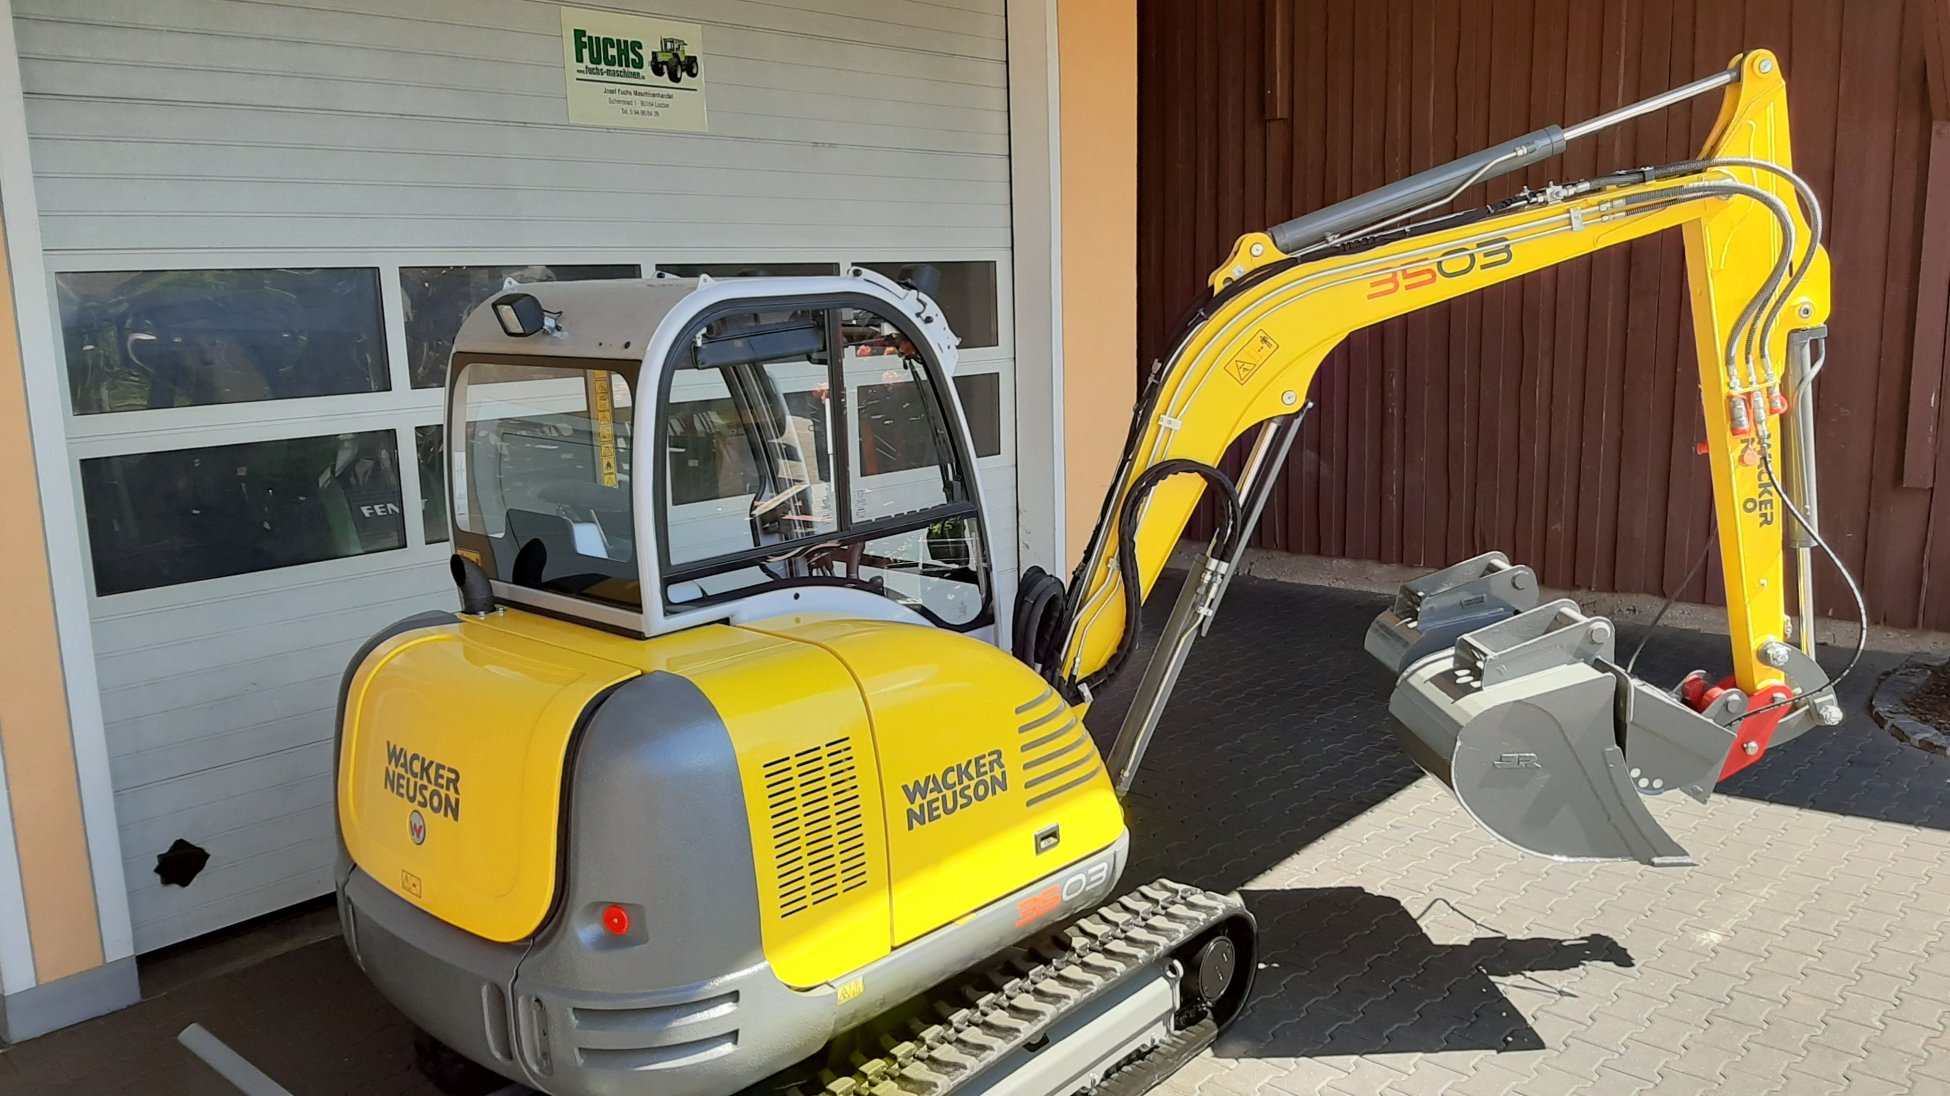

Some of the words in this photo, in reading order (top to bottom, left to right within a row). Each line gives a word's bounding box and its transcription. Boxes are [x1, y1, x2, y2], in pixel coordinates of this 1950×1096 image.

[1362, 237, 1513, 300] 3503
[384, 766, 461, 822] NEUSON
[386, 740, 461, 796] WACKER
[901, 749, 1005, 805] WACKER
[906, 770, 1008, 831] NEUSON
[1014, 862, 1108, 928] 3503
